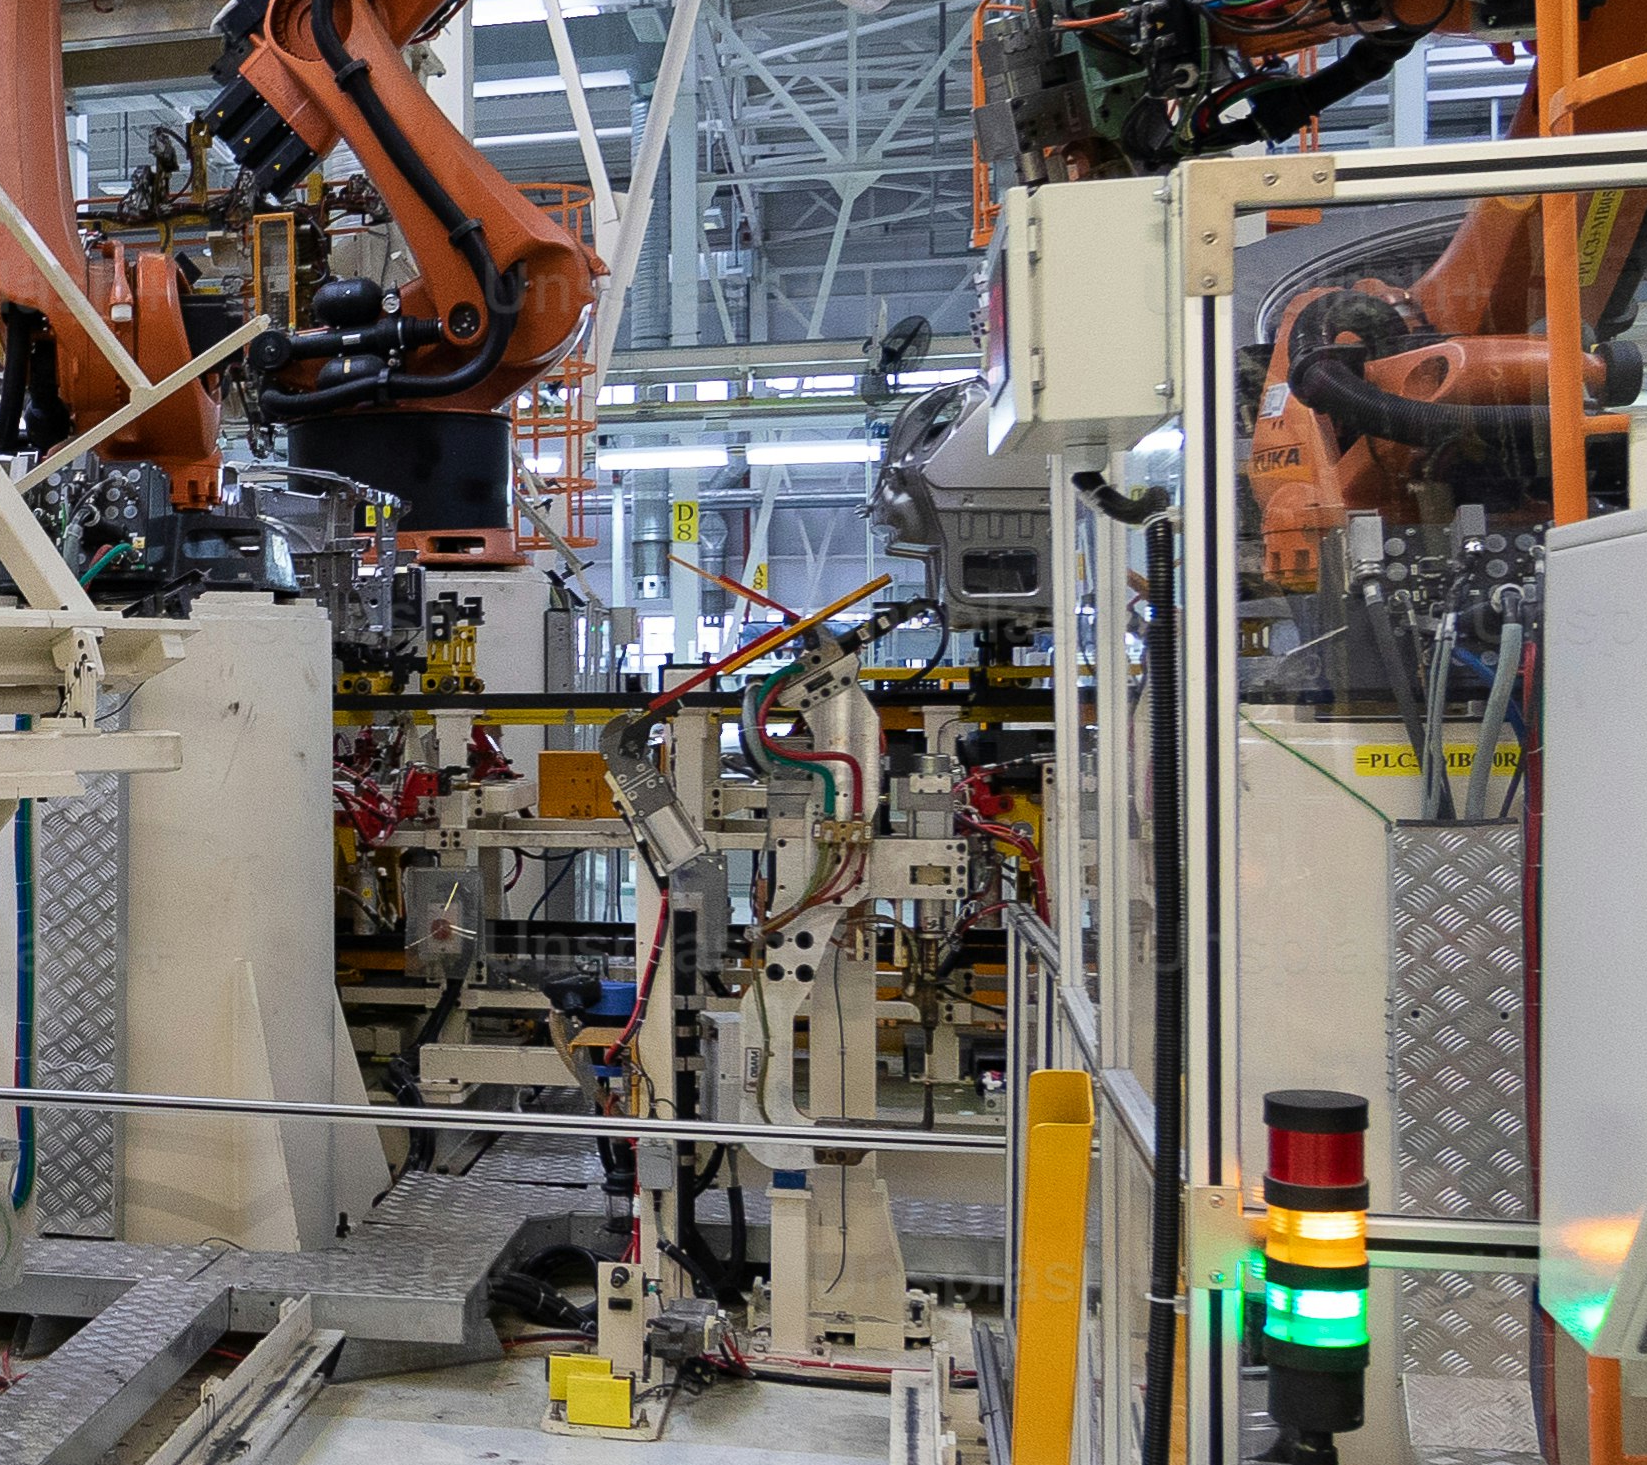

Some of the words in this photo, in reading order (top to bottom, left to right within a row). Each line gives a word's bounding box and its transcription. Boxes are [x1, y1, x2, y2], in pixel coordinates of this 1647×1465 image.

[1253, 447, 1301, 474] KUKA
[676, 502, 694, 521] D
[677, 524, 693, 542] 8
